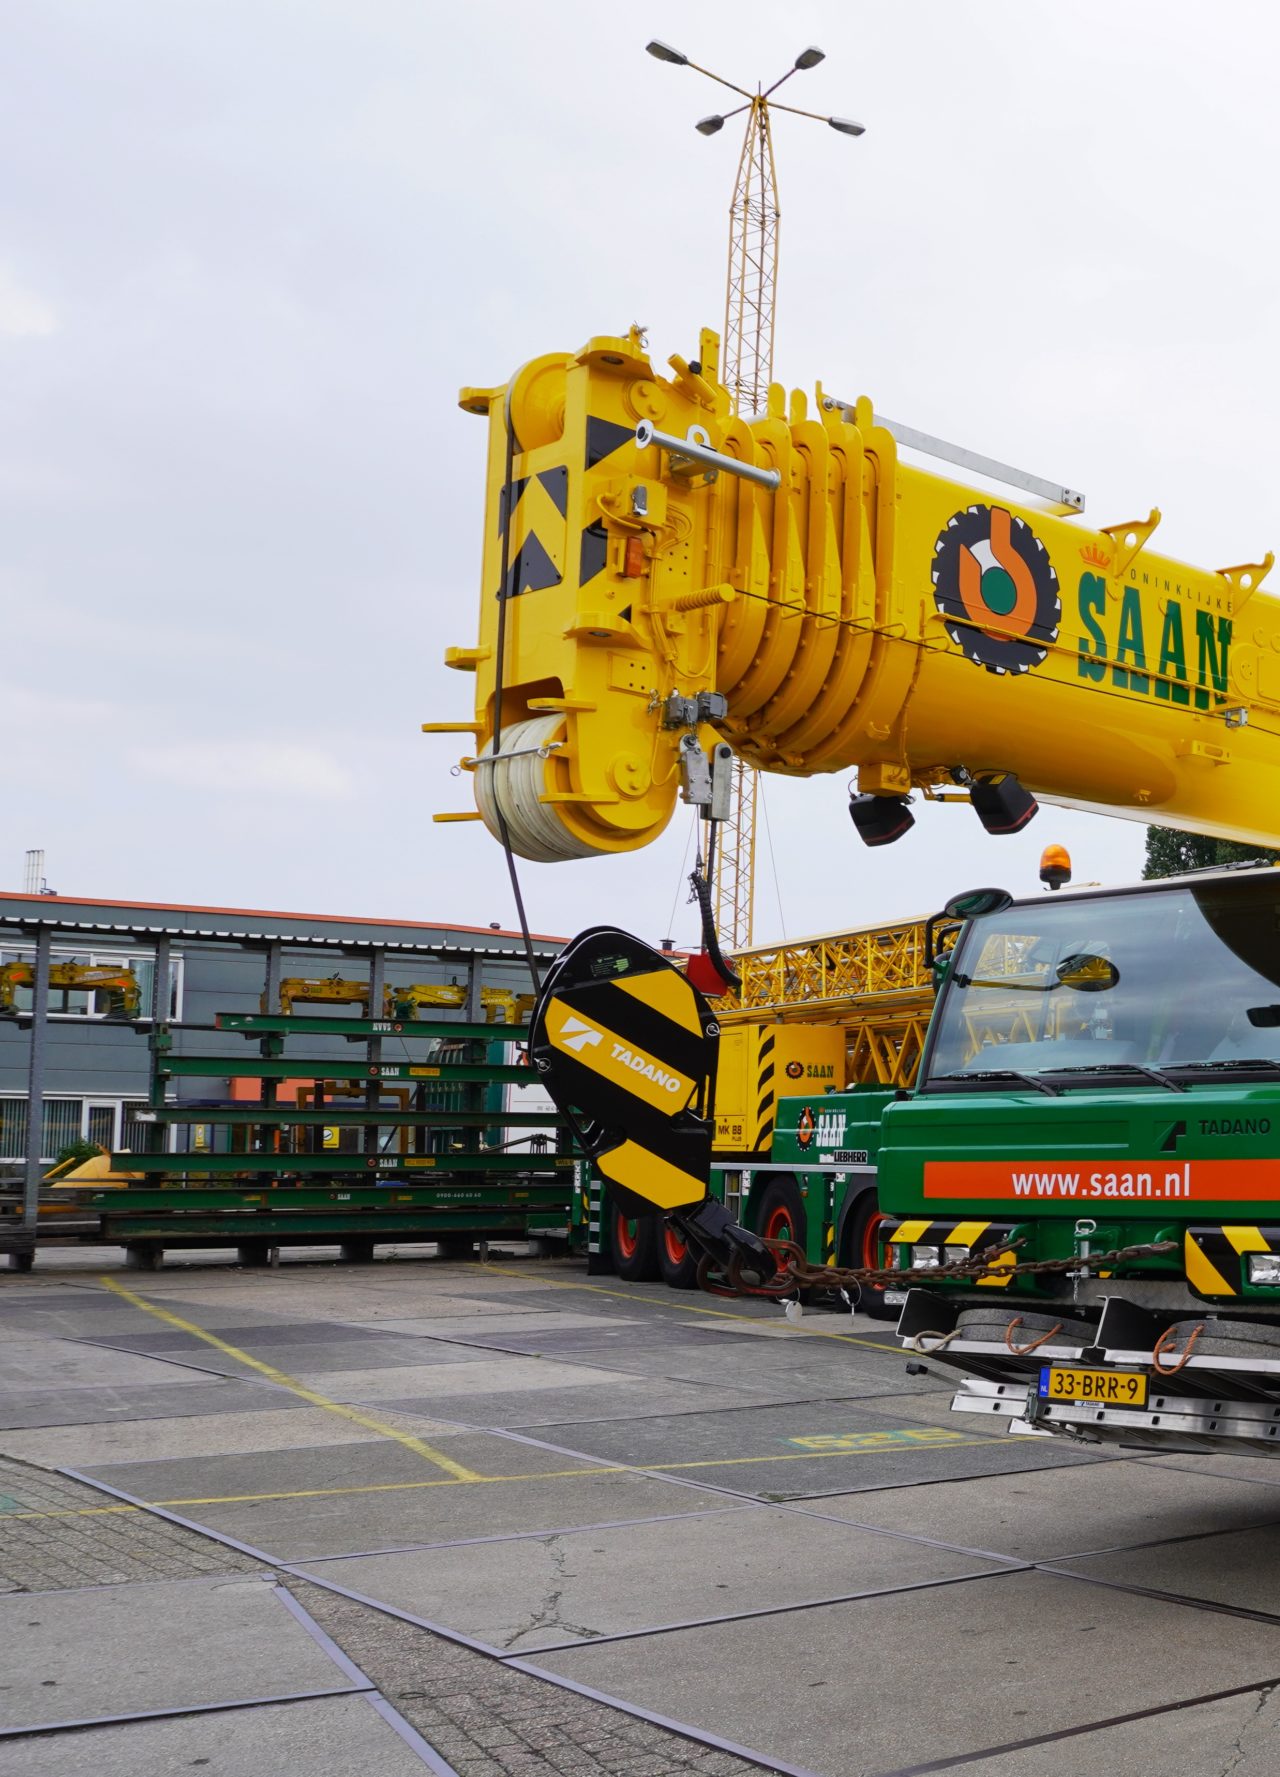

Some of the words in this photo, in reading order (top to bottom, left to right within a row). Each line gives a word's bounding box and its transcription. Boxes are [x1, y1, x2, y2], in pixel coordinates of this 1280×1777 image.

[1119, 567, 1233, 613] ONINKLIJKE
[1077, 571, 1233, 711] SAAN
[381, 1067, 399, 1076] SAAN
[610, 1043, 681, 1093] TADANO
[807, 1065, 834, 1078] SAAN
[718, 1125, 730, 1135] MK
[816, 1114, 847, 1147] SAAN
[1198, 1119, 1272, 1136] TADANO
[379, 1158, 398, 1168] SAAN
[834, 1151, 867, 1163] LIEBHERR
[1012, 1163, 1190, 1197] www.saan.nl
[1040, 1385, 1048, 1393] NL
[1054, 1372, 1139, 1400] 33-BRR-9
